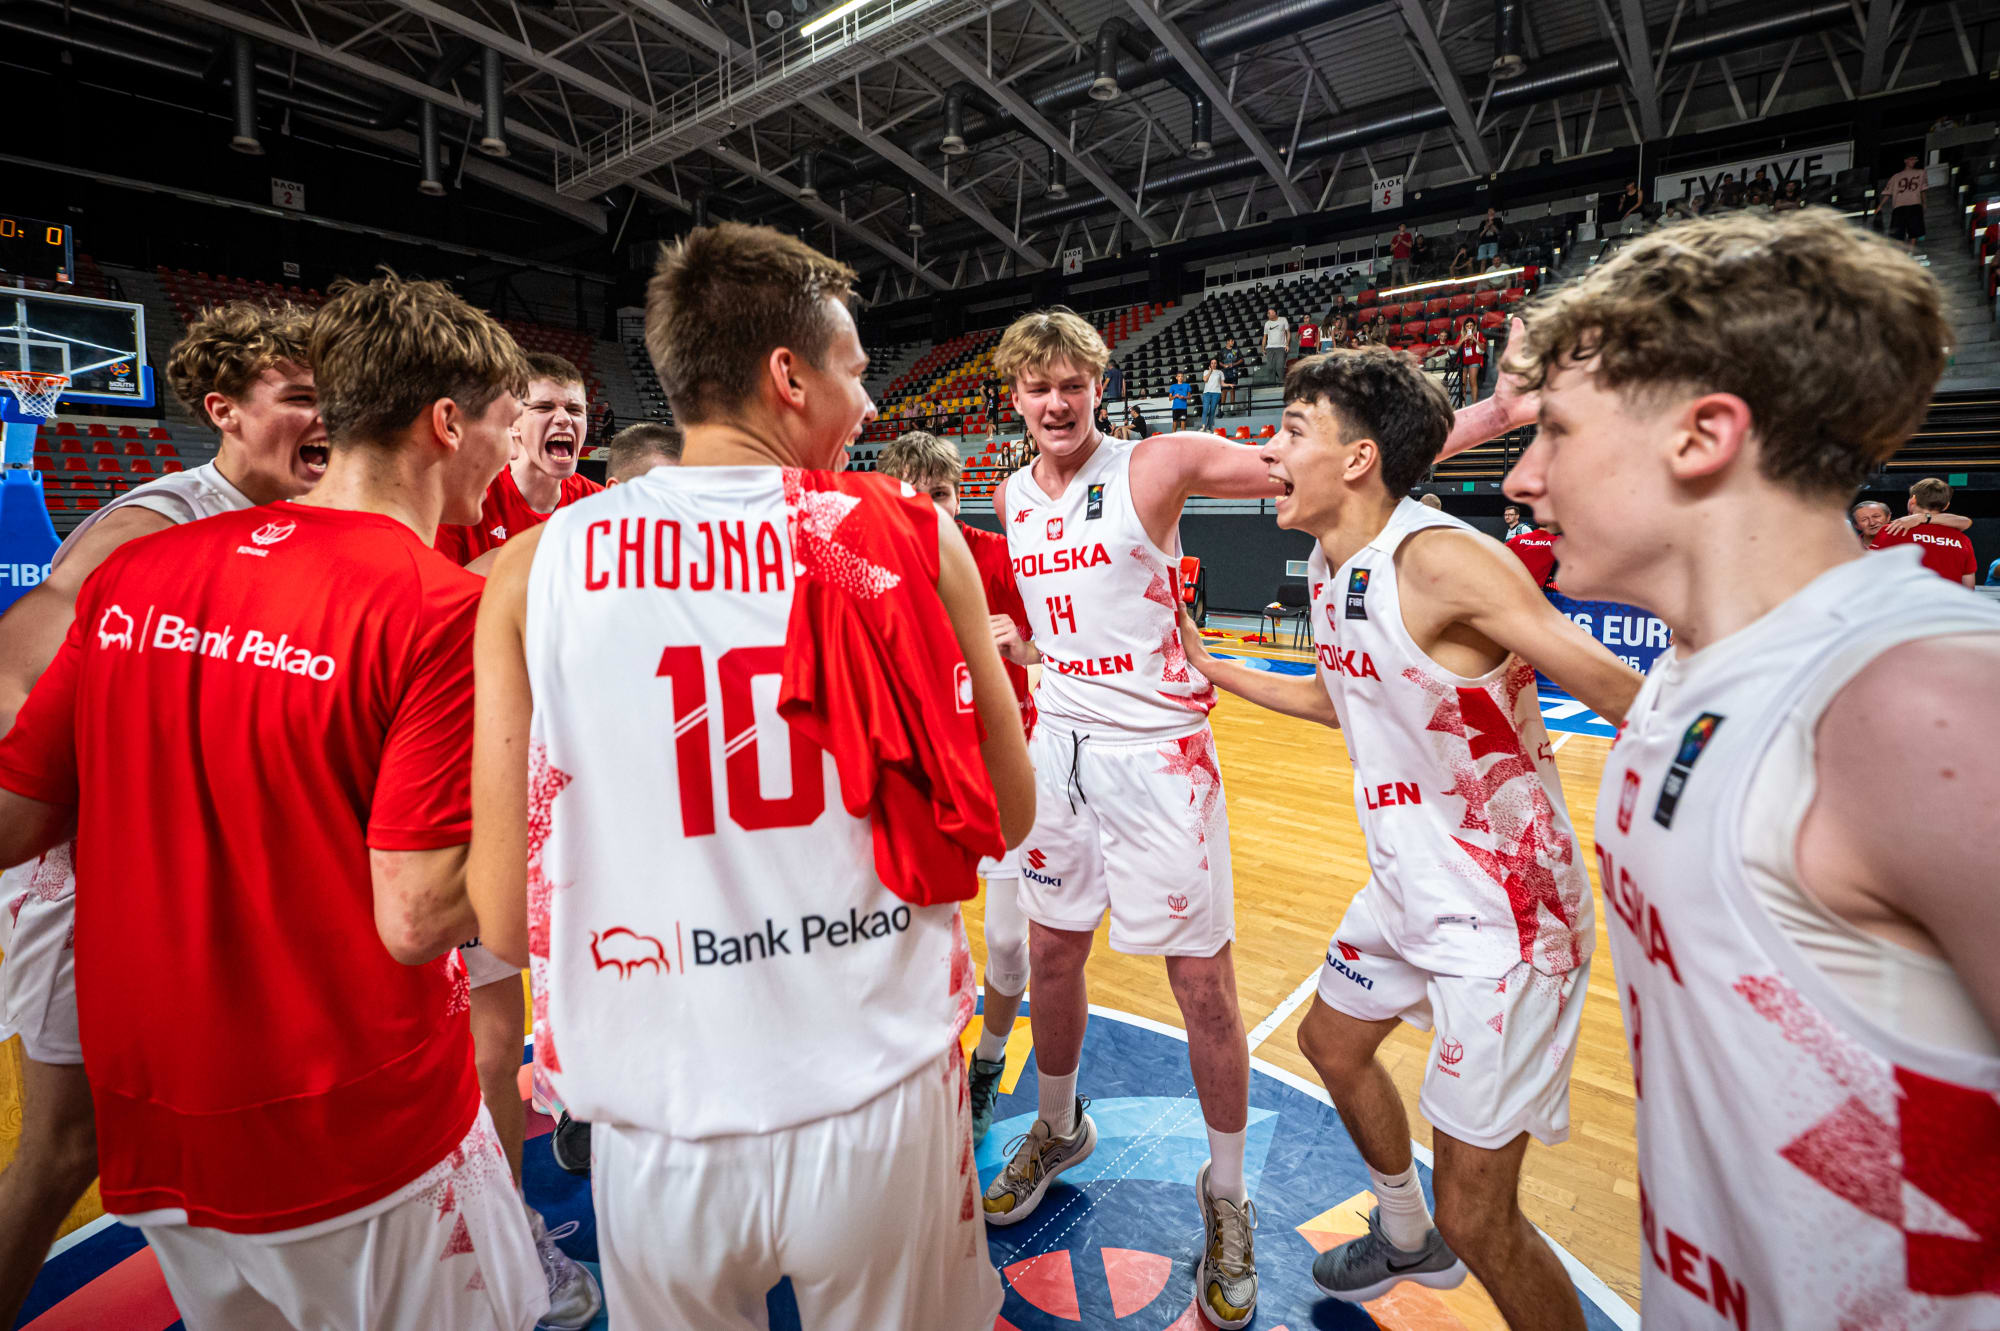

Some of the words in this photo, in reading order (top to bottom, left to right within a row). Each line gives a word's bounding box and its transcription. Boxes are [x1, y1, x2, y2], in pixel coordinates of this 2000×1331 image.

[1374, 178, 1401, 190] БЛОК
[1898, 176, 1920, 194] 96
[283, 191, 293, 205] 2
[1383, 190, 1391, 205] 5
[46, 226, 62, 245] 0
[1520, 538, 1552, 547] POLSKA
[1912, 533, 1963, 549] POLSKA
[1012, 543, 1112, 578] POLSKA
[1046, 594, 1077, 636] 14
[1602, 614, 1673, 649] EUR
[153, 614, 234, 660] Bank
[236, 630, 336, 681] Pekao
[655, 644, 826, 838] 10
[1021, 865, 1062, 888] UZUKI
[692, 918, 791, 966] Bank
[801, 905, 912, 954] Pekao
[1326, 952, 1374, 991] UZUKI
